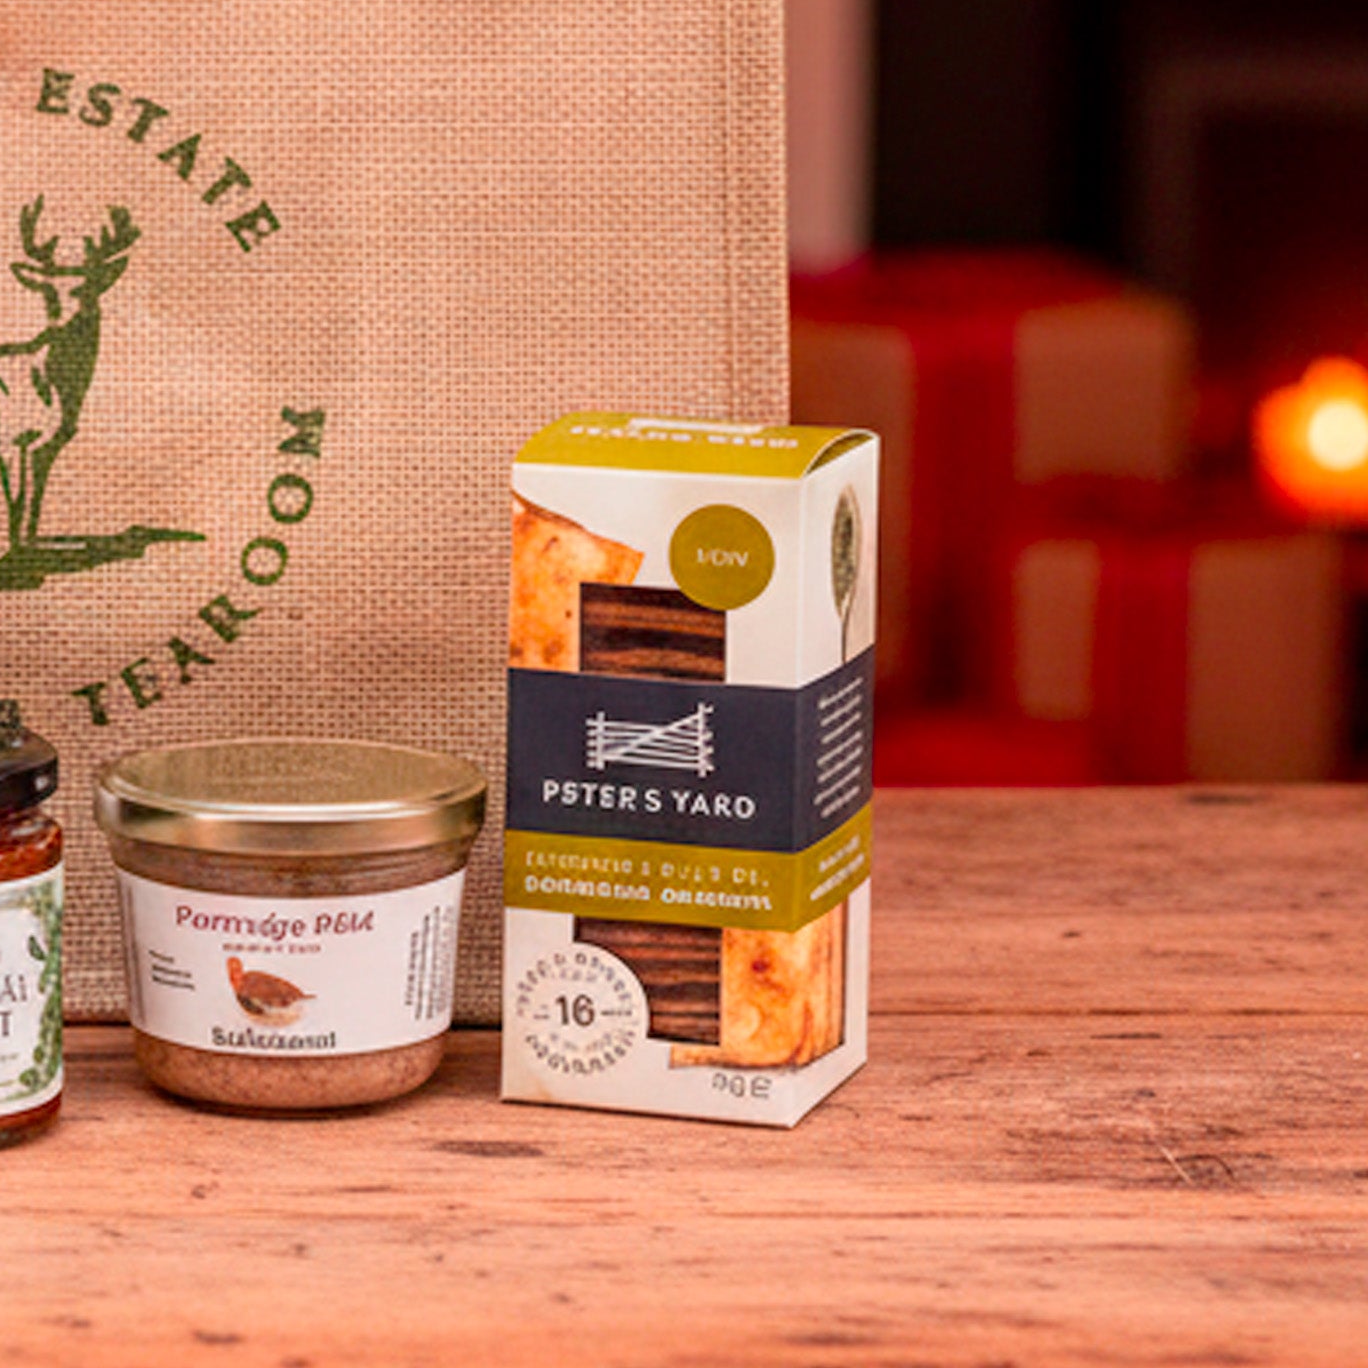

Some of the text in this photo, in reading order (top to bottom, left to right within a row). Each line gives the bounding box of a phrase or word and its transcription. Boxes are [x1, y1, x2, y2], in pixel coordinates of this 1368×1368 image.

[35, 68, 282, 252] ESTATE
[71, 406, 326, 727] TEAROOM
[555, 993, 595, 1026] 16
